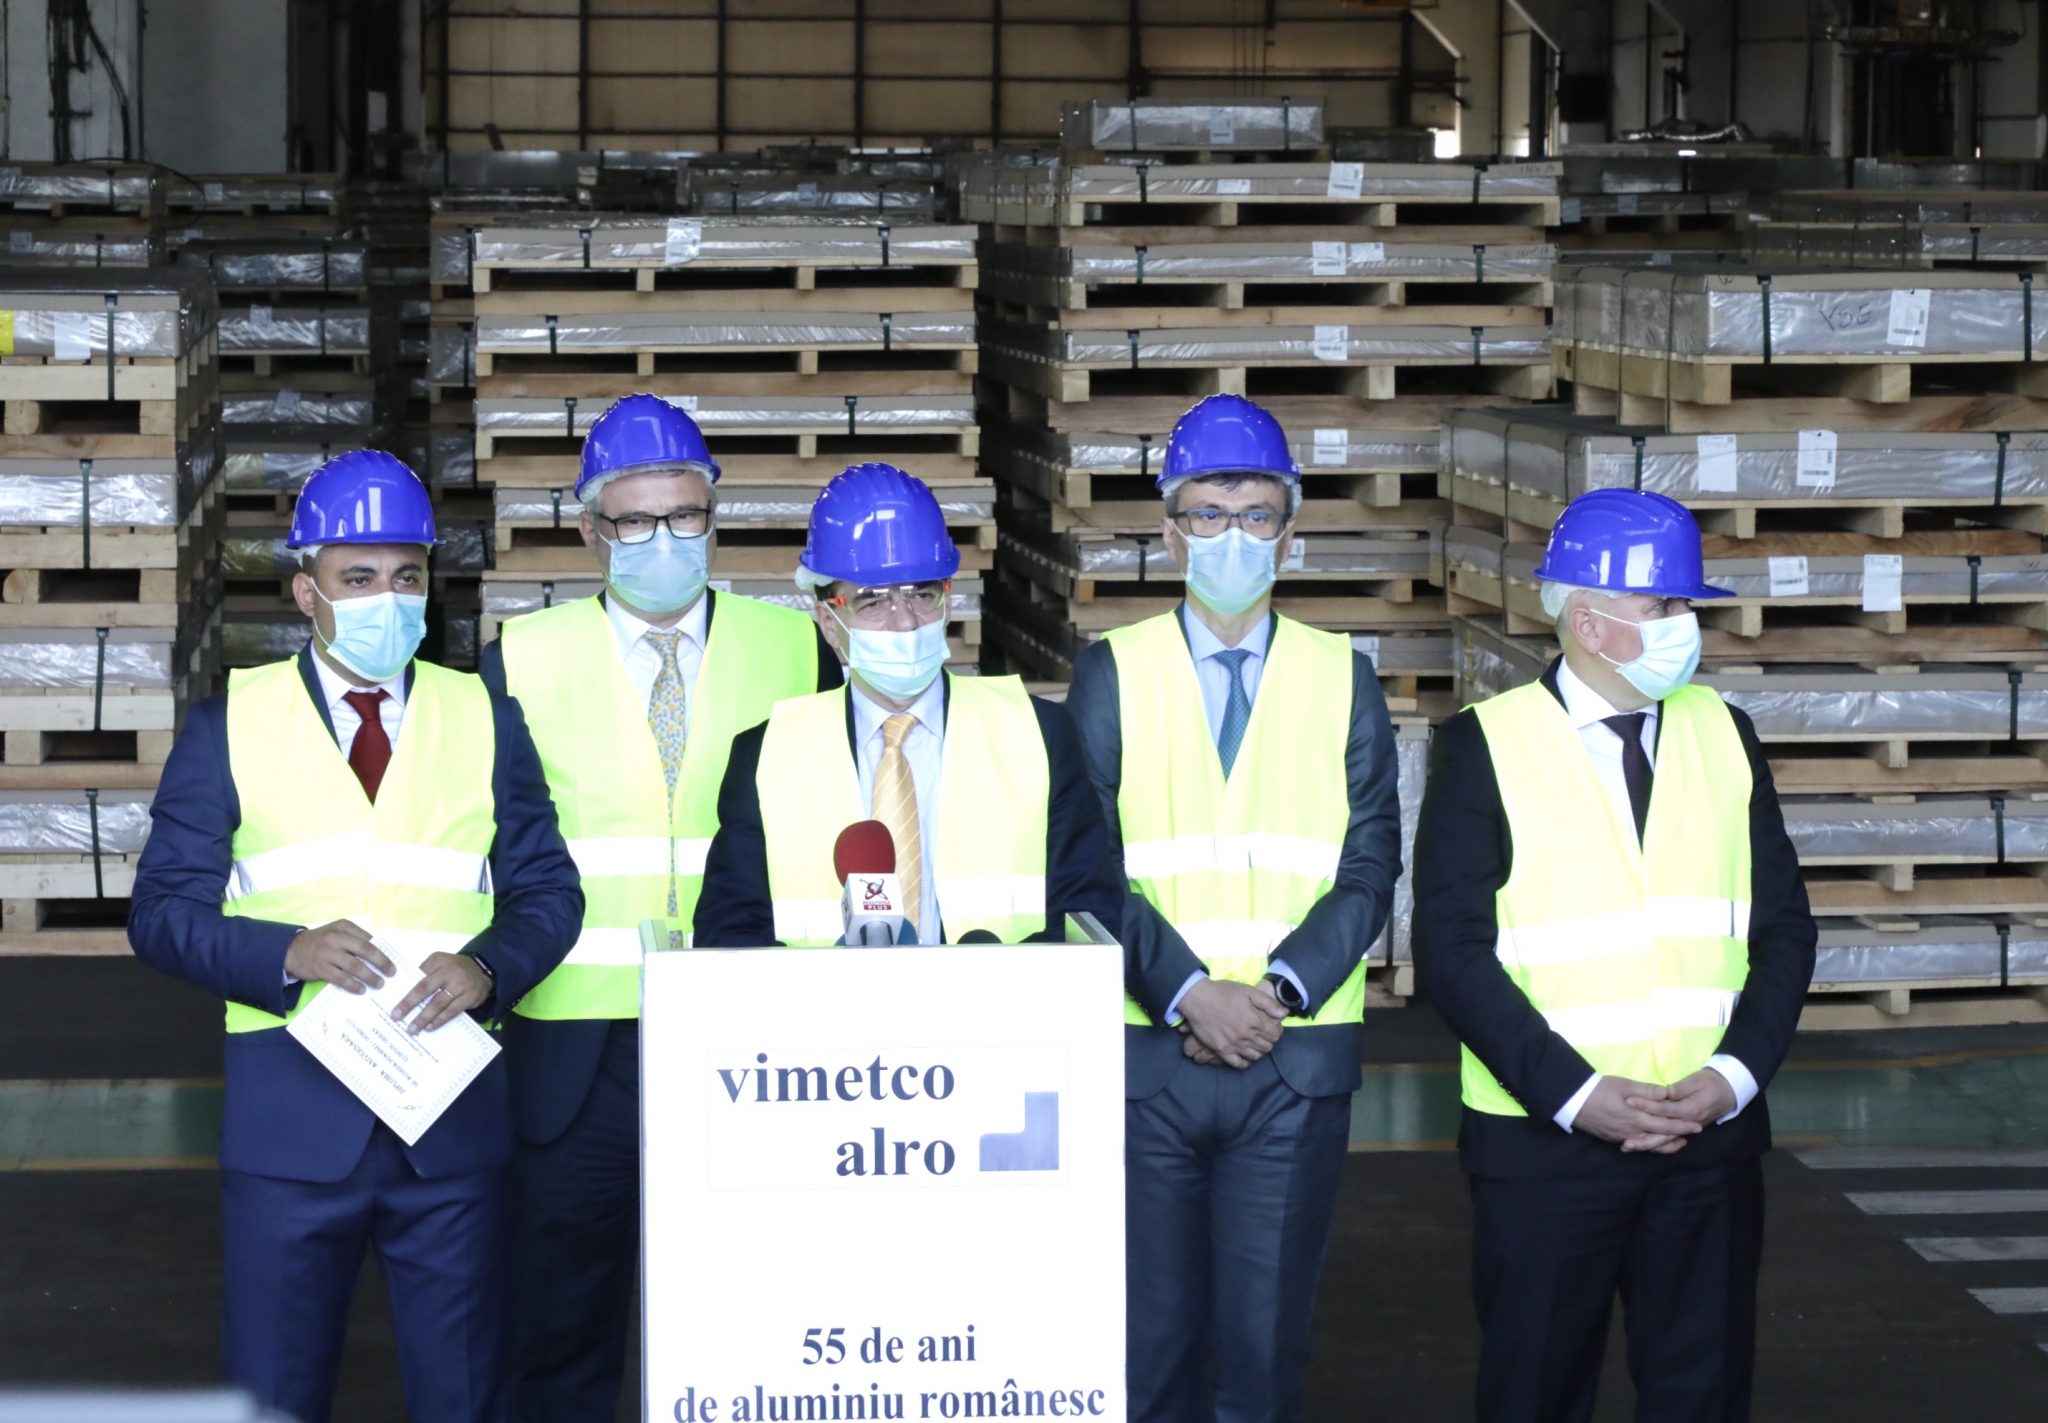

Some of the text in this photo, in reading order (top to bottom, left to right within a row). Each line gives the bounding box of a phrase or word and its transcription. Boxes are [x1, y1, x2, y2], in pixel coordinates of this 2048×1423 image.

[717, 1052, 955, 1103] vimetco
[836, 1127, 956, 1177] alro
[802, 1324, 976, 1366] 55 de ani
[673, 1378, 1105, 1423] de aluminiu românesc
